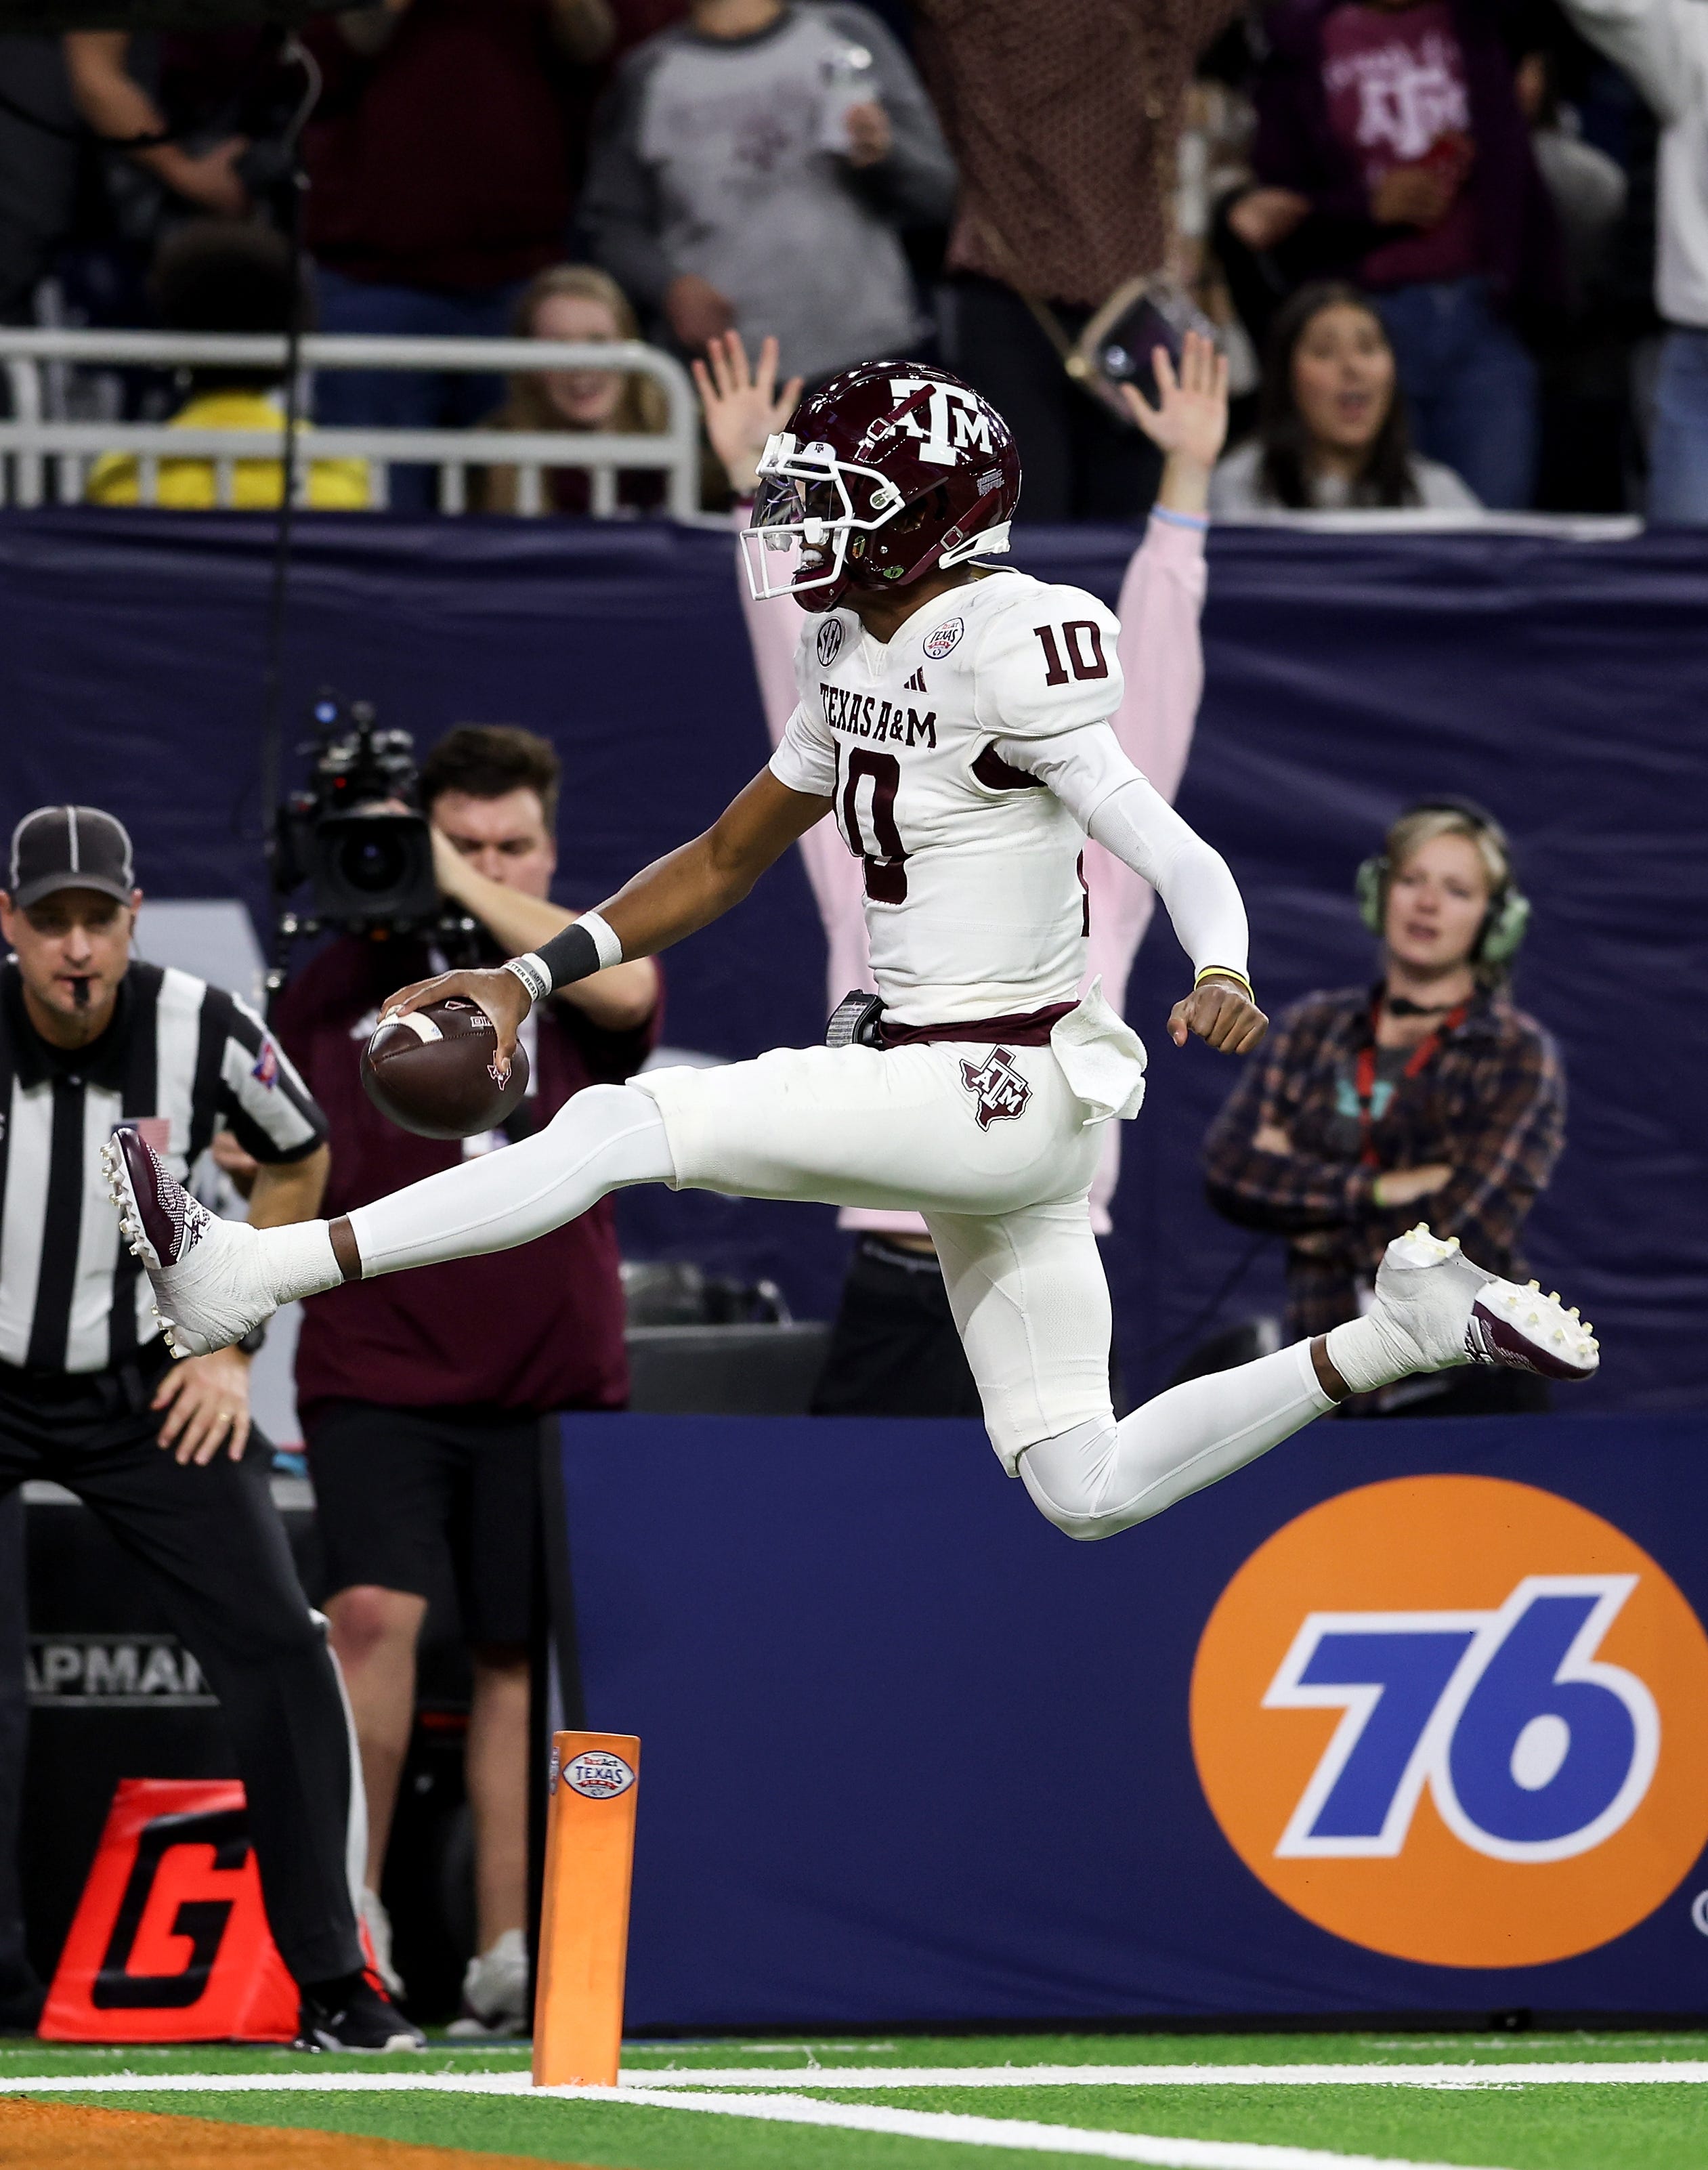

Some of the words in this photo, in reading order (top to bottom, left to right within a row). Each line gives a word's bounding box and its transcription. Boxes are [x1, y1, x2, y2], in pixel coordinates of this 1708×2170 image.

[818, 620, 840, 664] SEC
[930, 629, 958, 643] TEXAS
[1034, 620, 1109, 687] 10
[819, 682, 876, 738] TEXAS
[872, 700, 937, 749] A&M
[507, 962, 526, 978] TTER
[1261, 1574, 1661, 1865] 76
[576, 1766, 623, 1784] TEXAS
[91, 1808, 253, 2009] G
